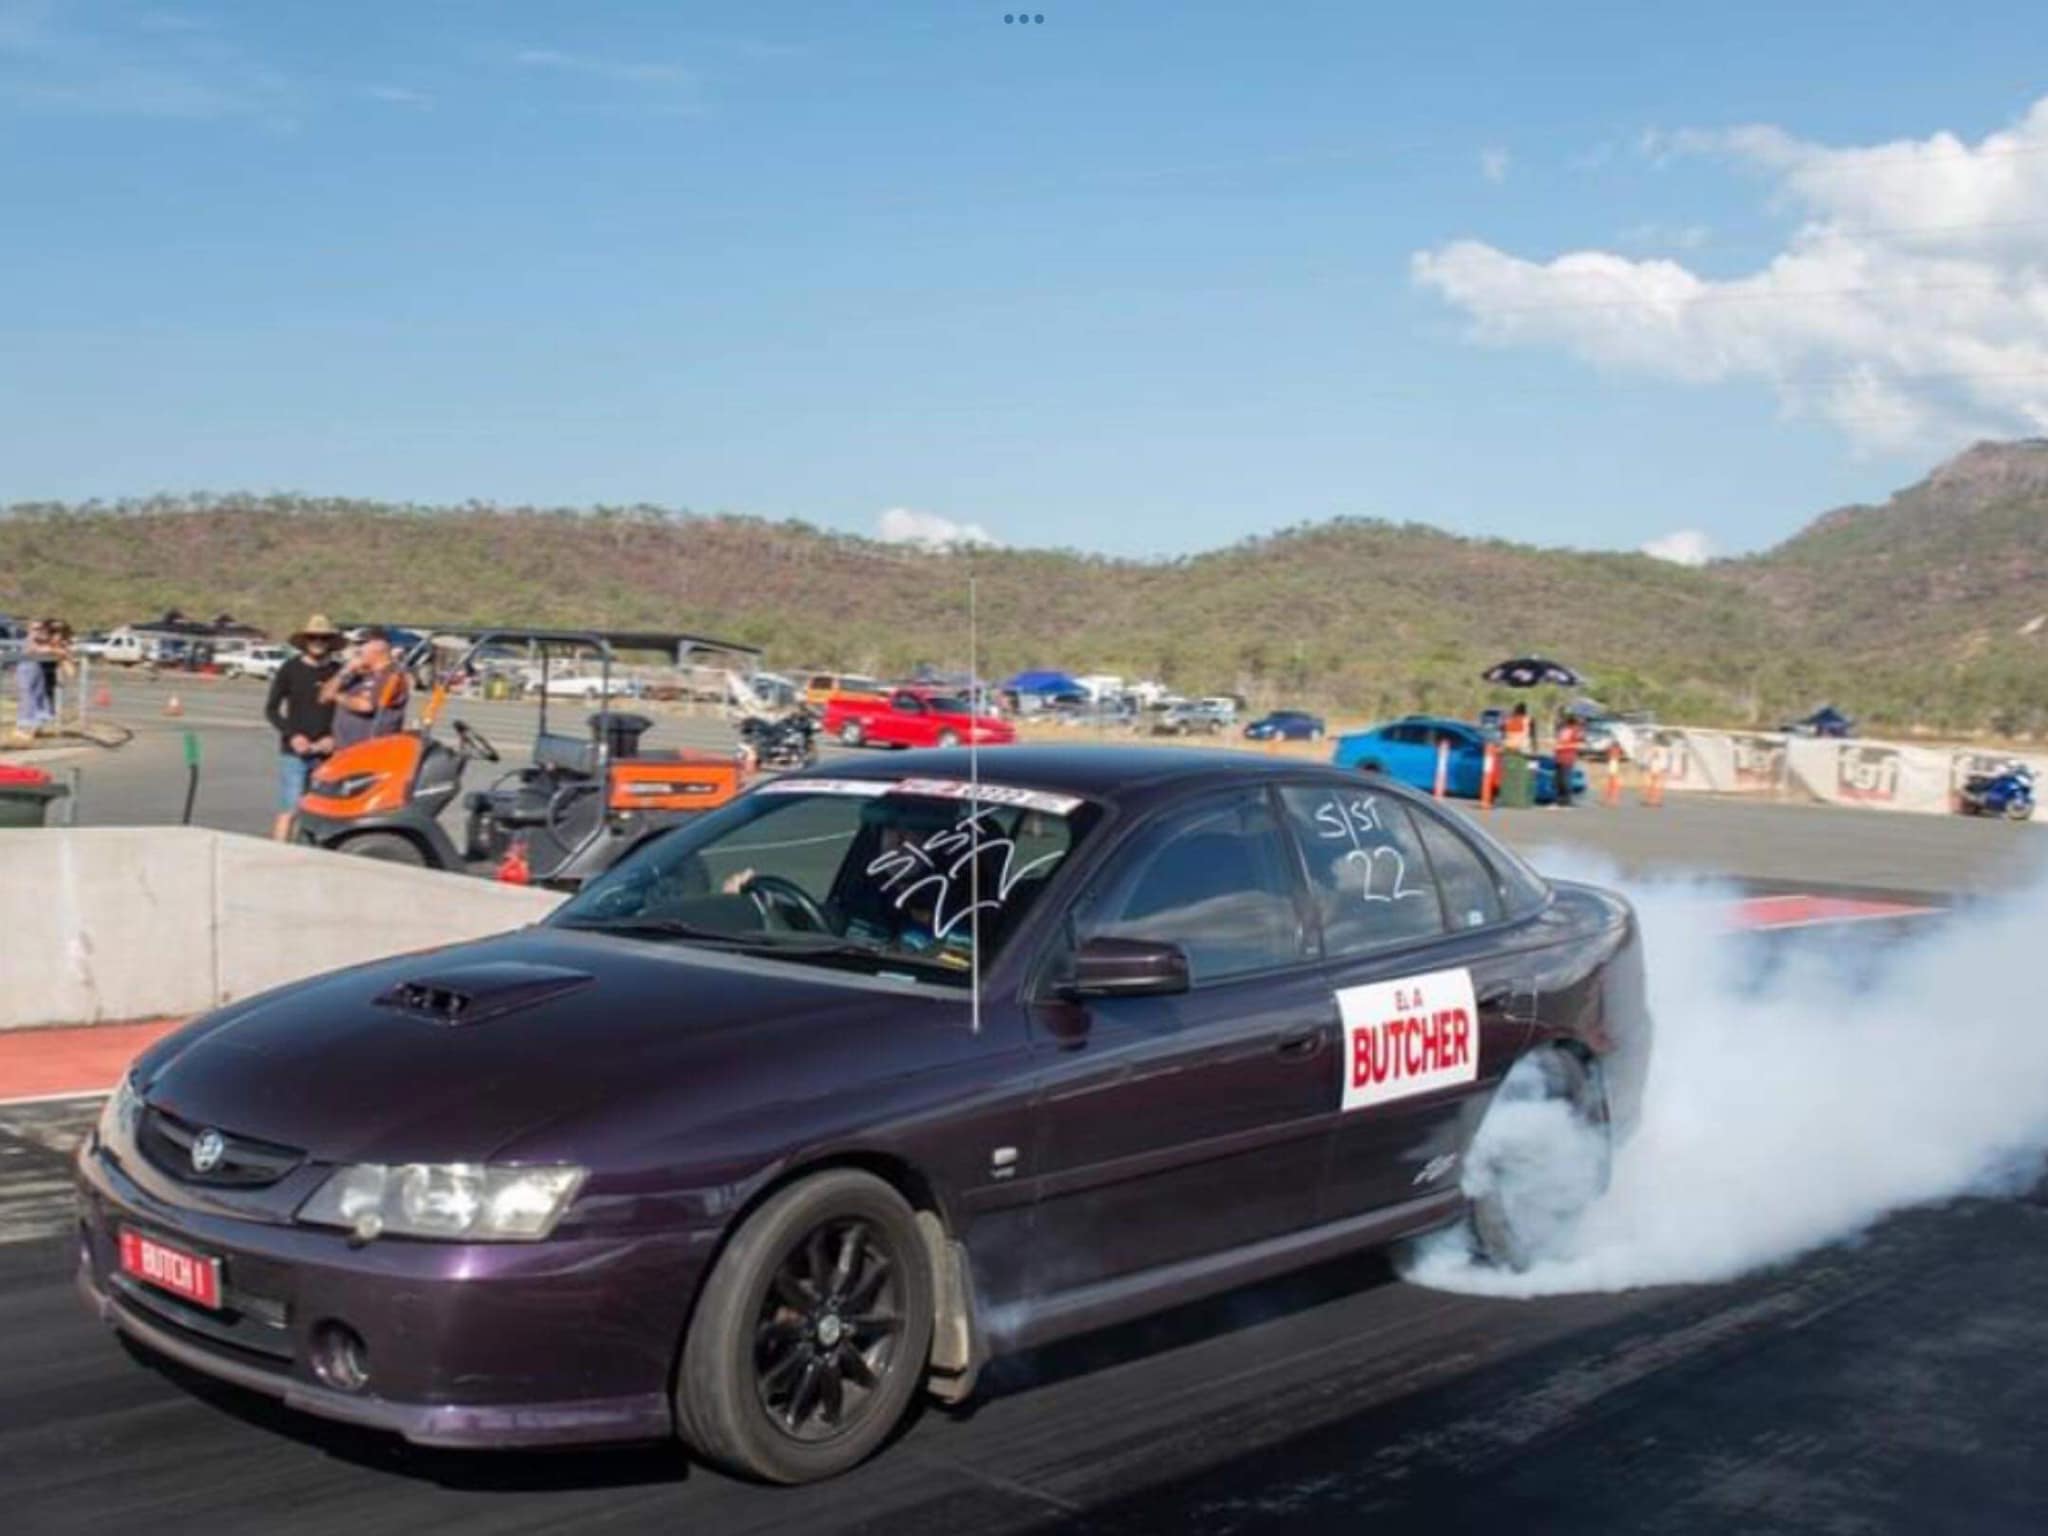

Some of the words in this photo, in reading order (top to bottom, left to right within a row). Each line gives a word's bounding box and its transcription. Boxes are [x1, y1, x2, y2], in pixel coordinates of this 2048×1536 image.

[895, 838, 1067, 939] 22
[1346, 845, 1425, 902] 22
[1352, 1007, 1469, 1089] BUTCHER
